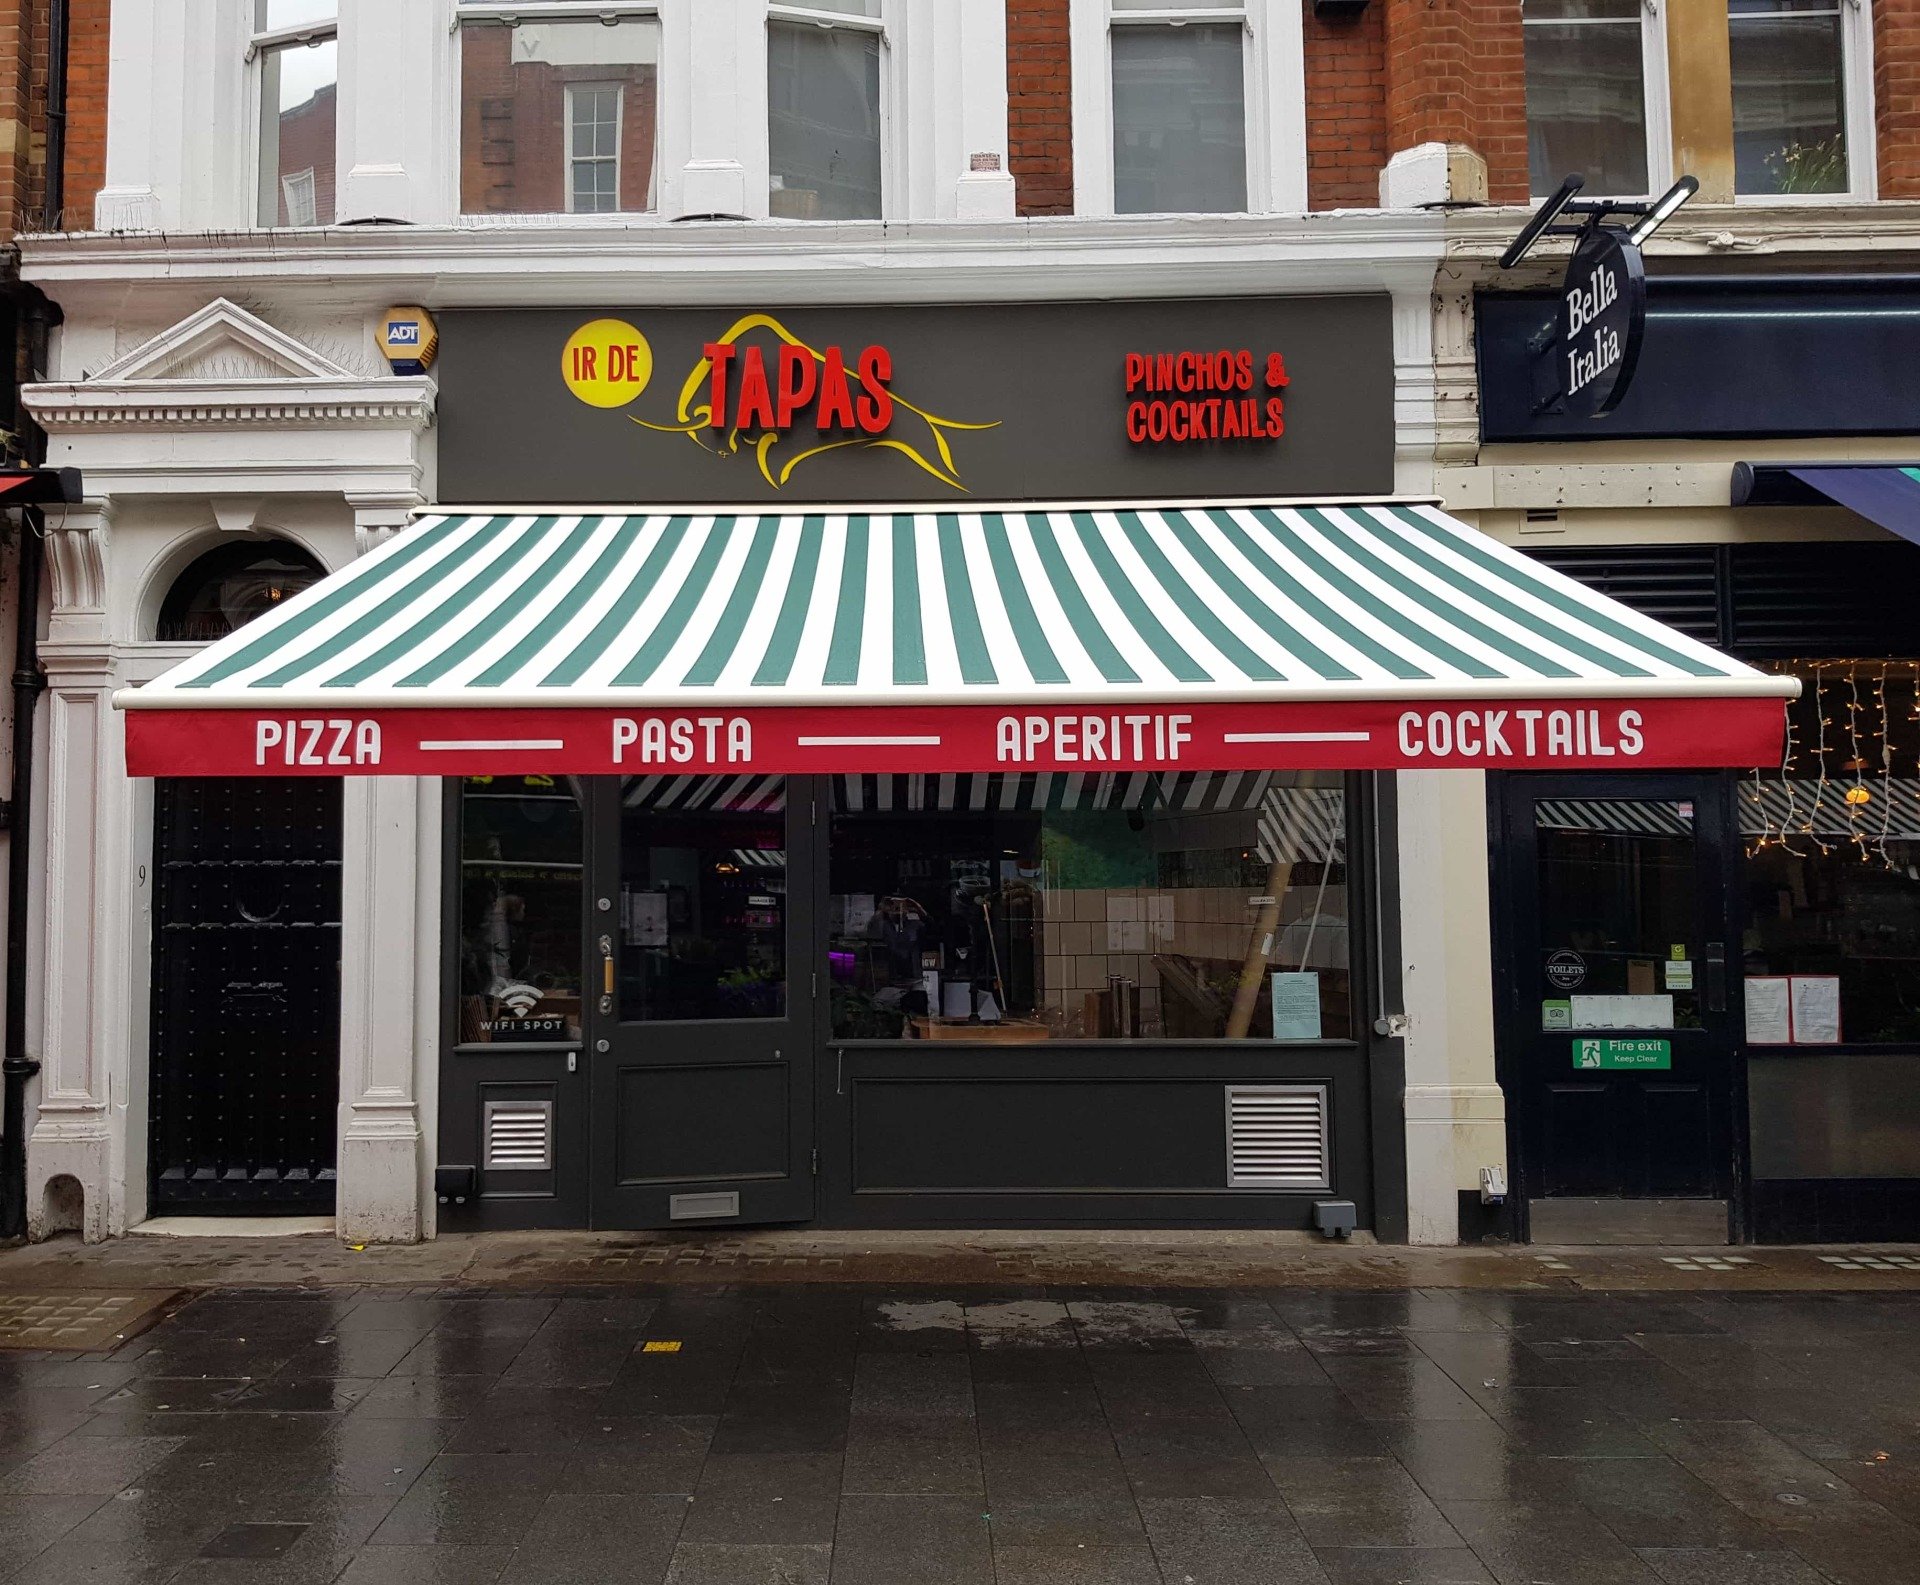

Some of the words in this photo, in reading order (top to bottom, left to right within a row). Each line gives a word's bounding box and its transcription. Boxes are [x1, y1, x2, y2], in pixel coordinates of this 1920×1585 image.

[1567, 264, 1618, 341] Bella
[388, 326, 418, 340] ADT
[573, 346, 597, 381] IR
[607, 344, 640, 382] DE
[1125, 349, 1254, 393] PINCHOS
[1265, 352, 1290, 388] &
[1567, 325, 1621, 396] Italia
[704, 343, 893, 433] TAPAS
[1126, 397, 1285, 443] COCKTAILS
[256, 719, 382, 766] PIZZA
[612, 717, 752, 764] PASTA
[996, 714, 1192, 762] APERITIF
[1398, 709, 1645, 757] COCKTAILS
[138, 864, 147, 888] 9
[1547, 965, 1585, 974] TOILETS
[480, 1021, 515, 1030] WIFI
[524, 1020, 562, 1030] SPOT
[1609, 1040, 1635, 1051] Fire
[1637, 1040, 1662, 1051] exit
[1614, 1055, 1635, 1063] Keep
[1636, 1054, 1658, 1063] Clear
